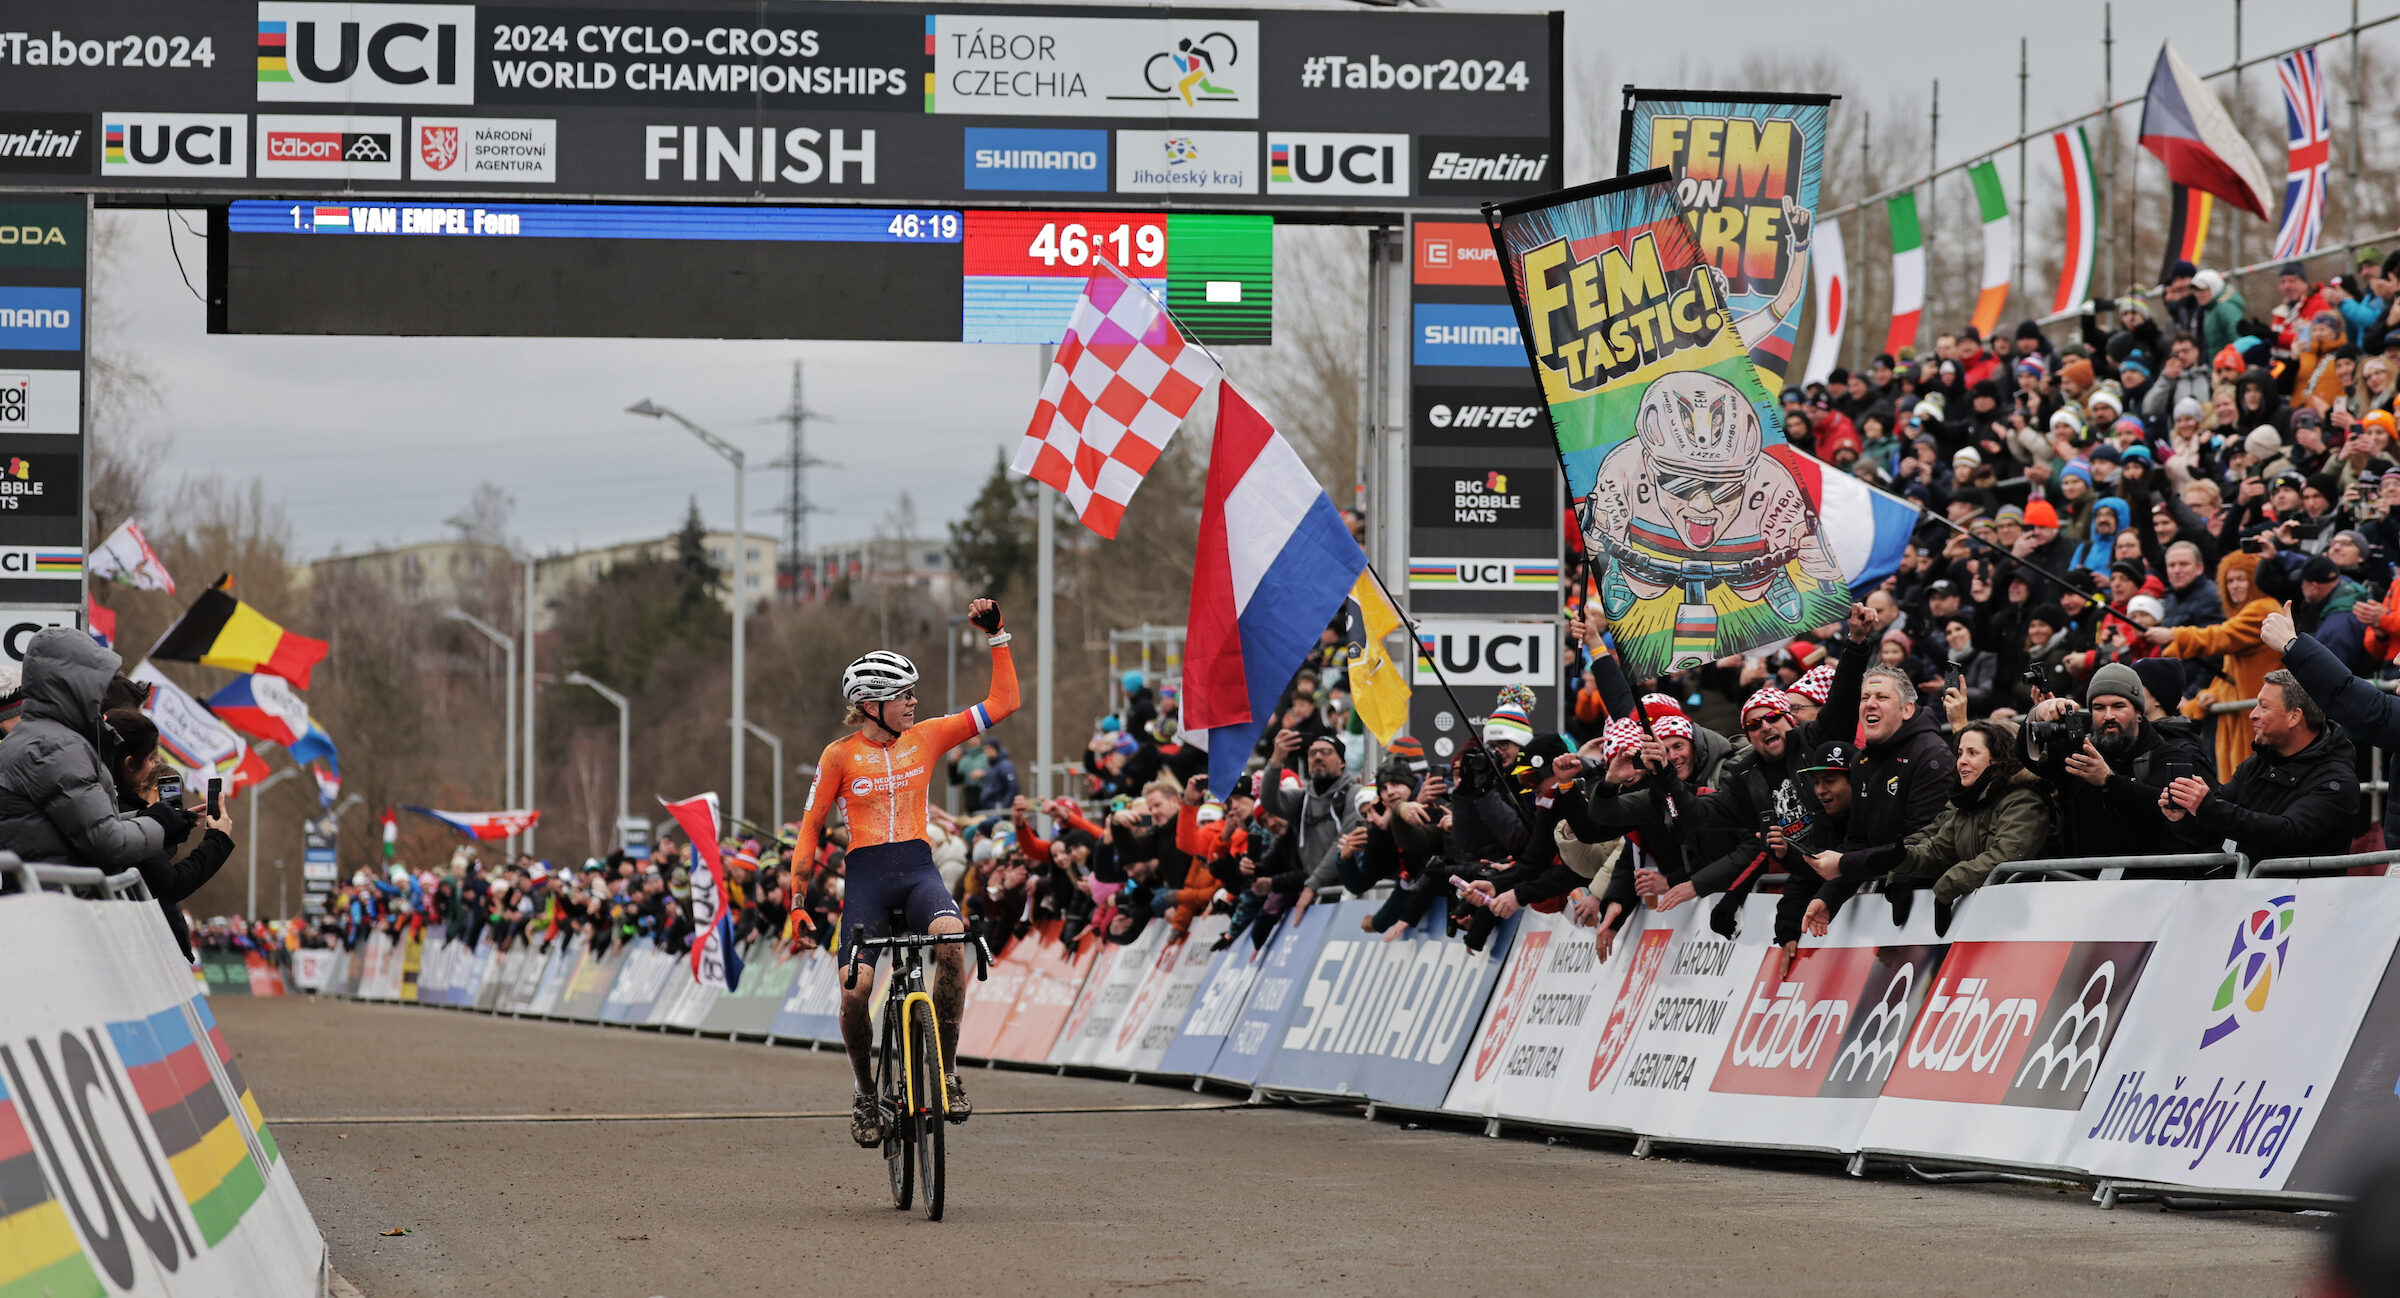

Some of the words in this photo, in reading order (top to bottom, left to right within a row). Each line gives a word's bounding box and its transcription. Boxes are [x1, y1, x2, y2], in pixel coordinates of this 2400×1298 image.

[296, 21, 456, 86] UCI
[493, 25, 568, 52] 2024
[576, 26, 819, 57] CYCLO-CROSS
[952, 28, 1055, 61] TÁBOR
[492, 60, 617, 90] WORLD
[624, 63, 907, 96] CHAMPIONSHIPS
[952, 71, 1087, 98] CZECHIA
[1302, 54, 1529, 92] #Tabor2024
[130, 125, 232, 166] UCI
[475, 129, 533, 142] NÁRODNÍ
[475, 144, 546, 157] SPORTOVNÍ
[475, 160, 543, 172] AGENTURA
[645, 124, 876, 185] FINISH
[975, 149, 1097, 171] SHIMANO
[1294, 143, 1394, 184] UCI
[1428, 152, 1549, 182] Santini
[1651, 118, 1793, 200] FEM
[1132, 169, 1208, 188] Jihočeský
[1213, 170, 1244, 188] kraj
[1677, 177, 1723, 208] ON
[352, 207, 397, 233] VAN
[402, 208, 469, 234] EMPEL
[473, 210, 520, 235] Fem
[888, 213, 957, 239] 46:19
[1028, 222, 1165, 268] 46:19
[1457, 247, 1498, 261] SKUPI
[1688, 205, 1782, 280] RE
[1523, 233, 1666, 357] FEM
[1558, 267, 1724, 384] TASTIC!
[1452, 405, 1538, 429] HI-TEC
[0, 481, 44, 495] BBLE
[1455, 480, 1483, 494] BIG
[1455, 495, 1521, 509] BOBBLE
[1455, 509, 1498, 523] HATS
[2, 552, 29, 572] CI
[1459, 564, 1507, 583] UCI
[1441, 634, 1540, 674] UCI
[1282, 937, 1490, 1065] SHIMANO
[1648, 988, 1735, 1036] SPORTOVNÍ
[1624, 1052, 1698, 1092] AGENTURA
[2088, 1070, 2246, 1171] Jihočeský
[2226, 1079, 2314, 1180] kraj
[0, 1026, 198, 1291] UCI
